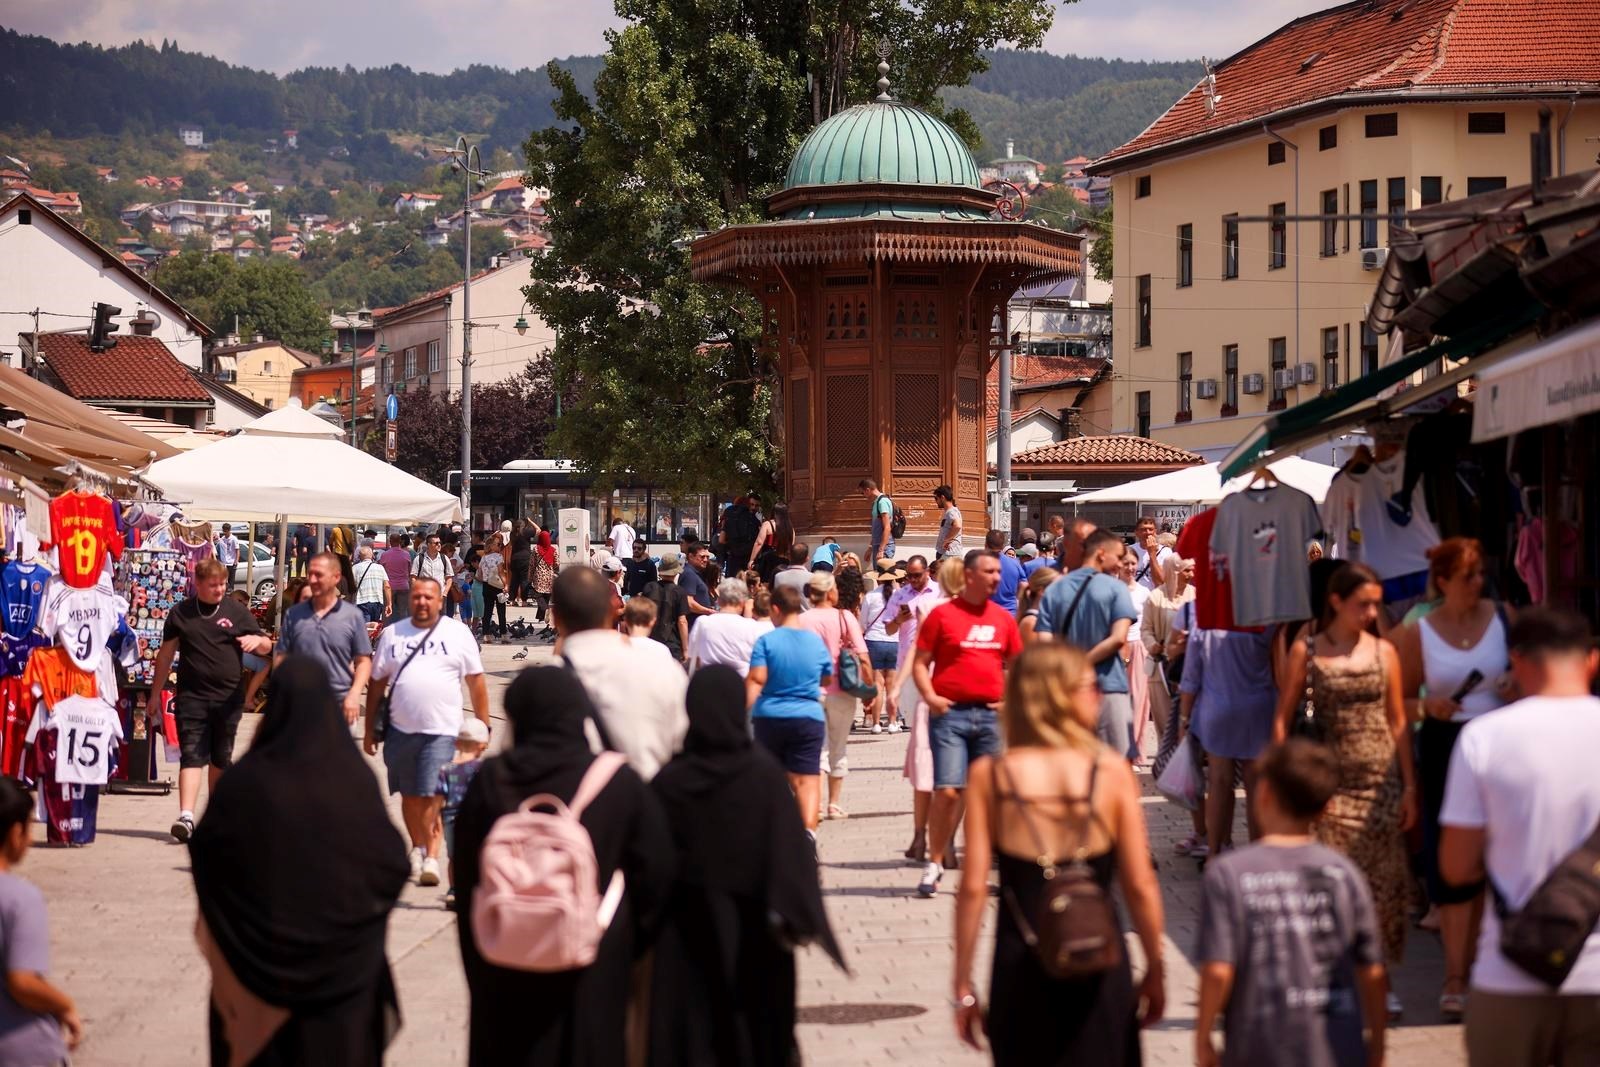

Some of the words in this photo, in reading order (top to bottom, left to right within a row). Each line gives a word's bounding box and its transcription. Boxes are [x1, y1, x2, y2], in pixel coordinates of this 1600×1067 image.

[76, 624, 92, 661] 9
[391, 641, 448, 658] USPA
[67, 728, 102, 767] 15
